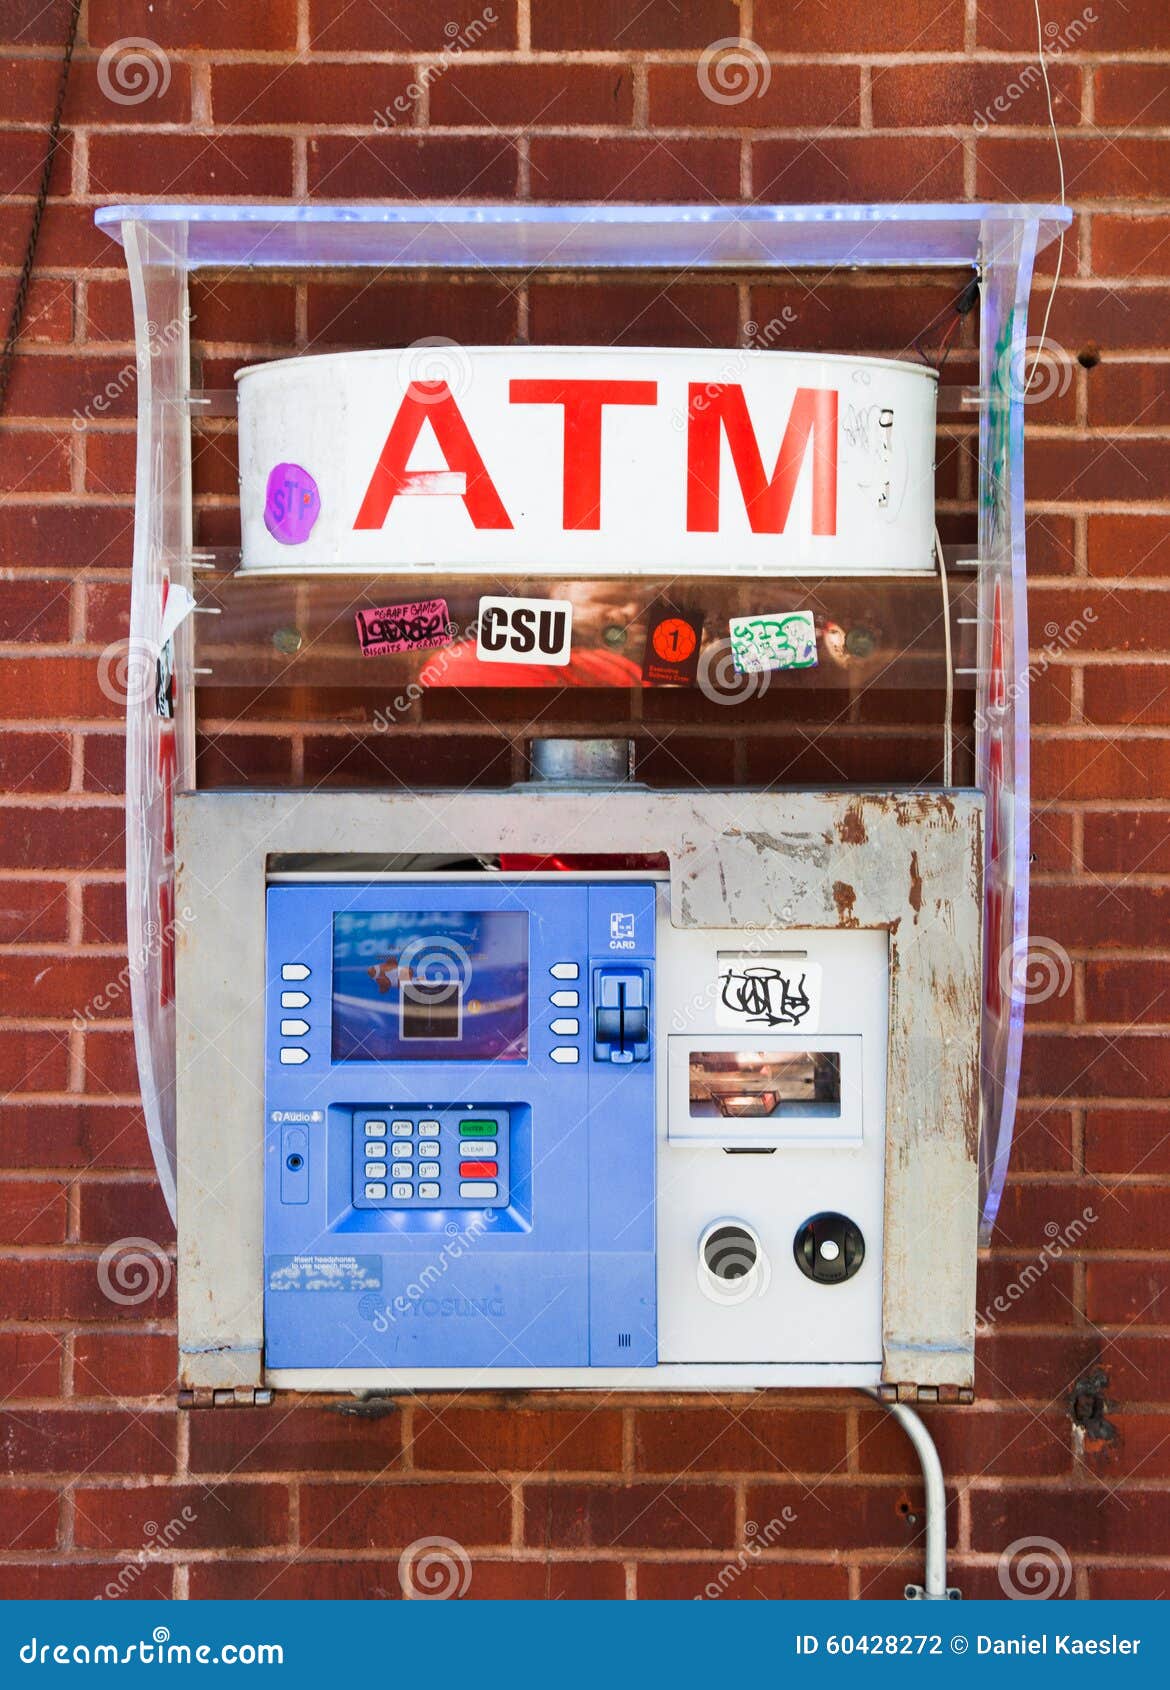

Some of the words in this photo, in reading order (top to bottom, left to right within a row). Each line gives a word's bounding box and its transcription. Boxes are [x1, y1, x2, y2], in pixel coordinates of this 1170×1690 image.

[352, 379, 839, 536] ATM
[273, 480, 313, 524] STP
[480, 607, 566, 655] CSU
[668, 630, 679, 652] 1
[610, 941, 636, 950] CARD
[283, 1111, 310, 1122] Audio
[399, 1187, 406, 1196] 0
